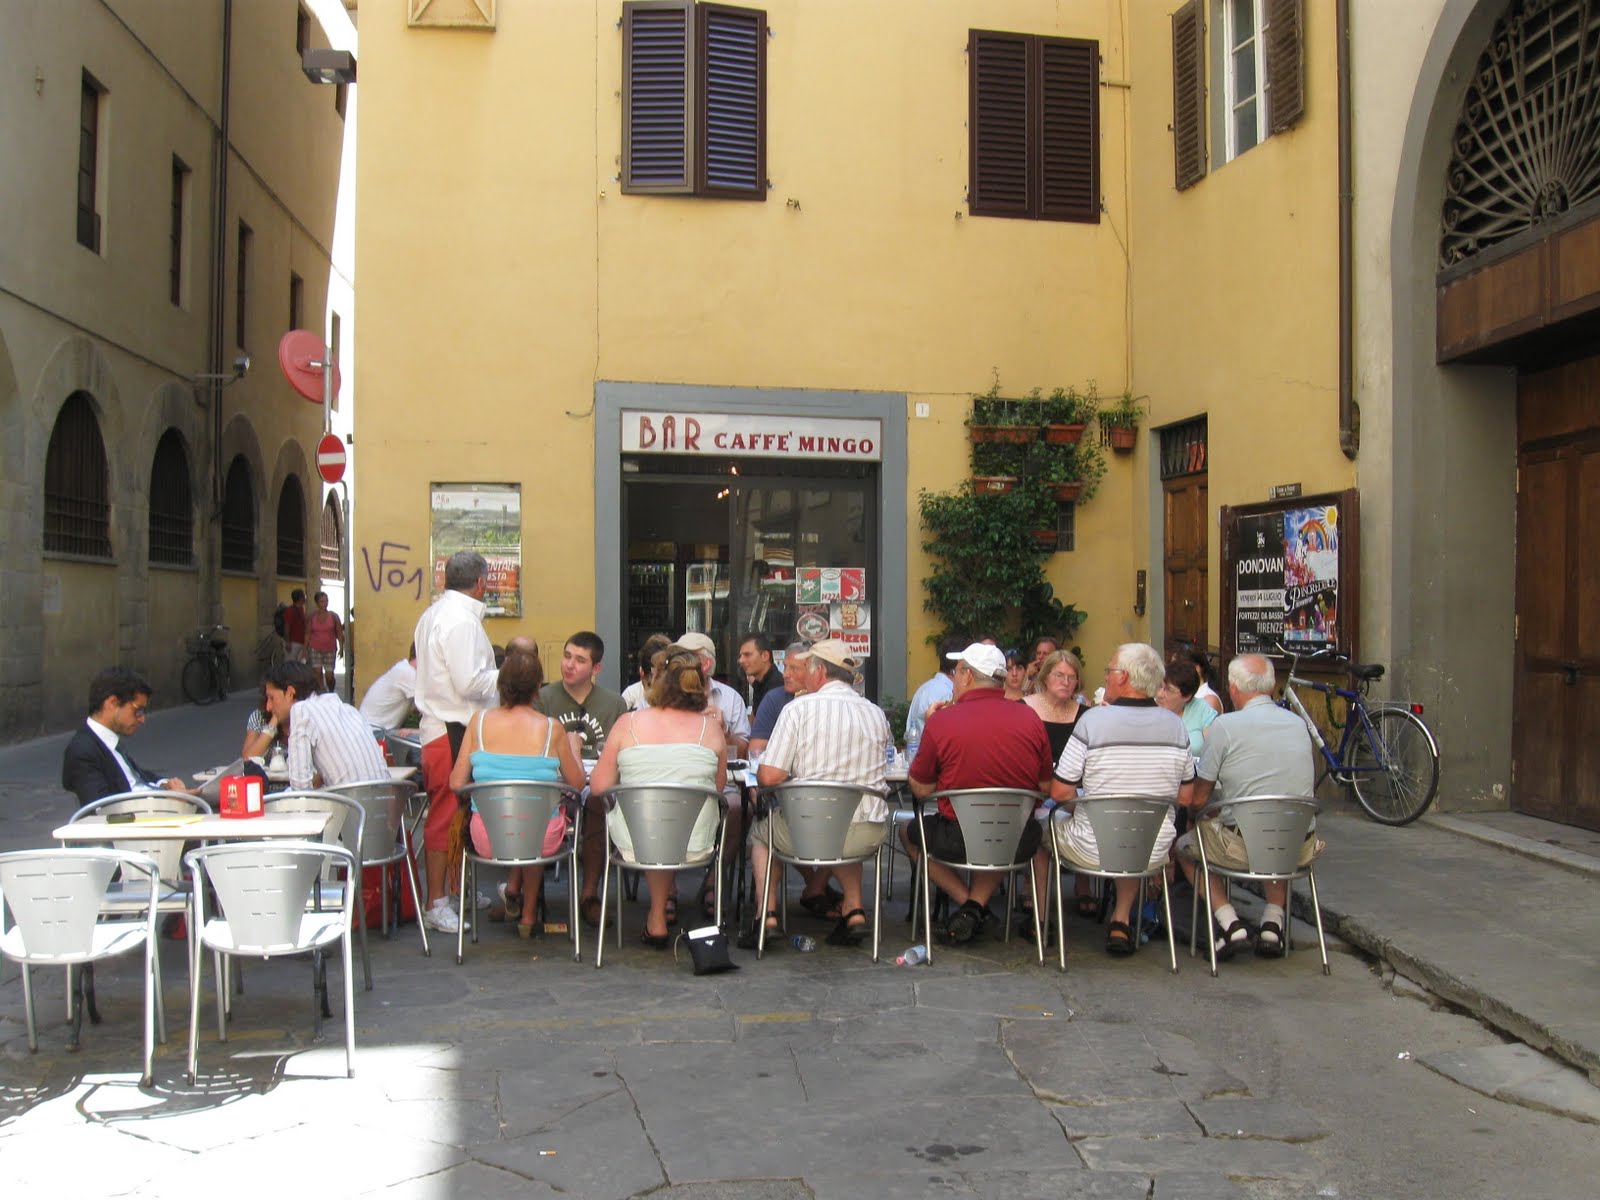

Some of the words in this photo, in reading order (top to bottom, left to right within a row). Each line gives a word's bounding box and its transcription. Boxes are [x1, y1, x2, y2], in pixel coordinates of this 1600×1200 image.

[639, 415, 701, 450] BAR
[798, 436, 874, 454] MINGO
[1239, 558, 1284, 574] DONOVAN
[1268, 611, 1284, 620] BASSO
[1257, 622, 1284, 634] FIRENZE
